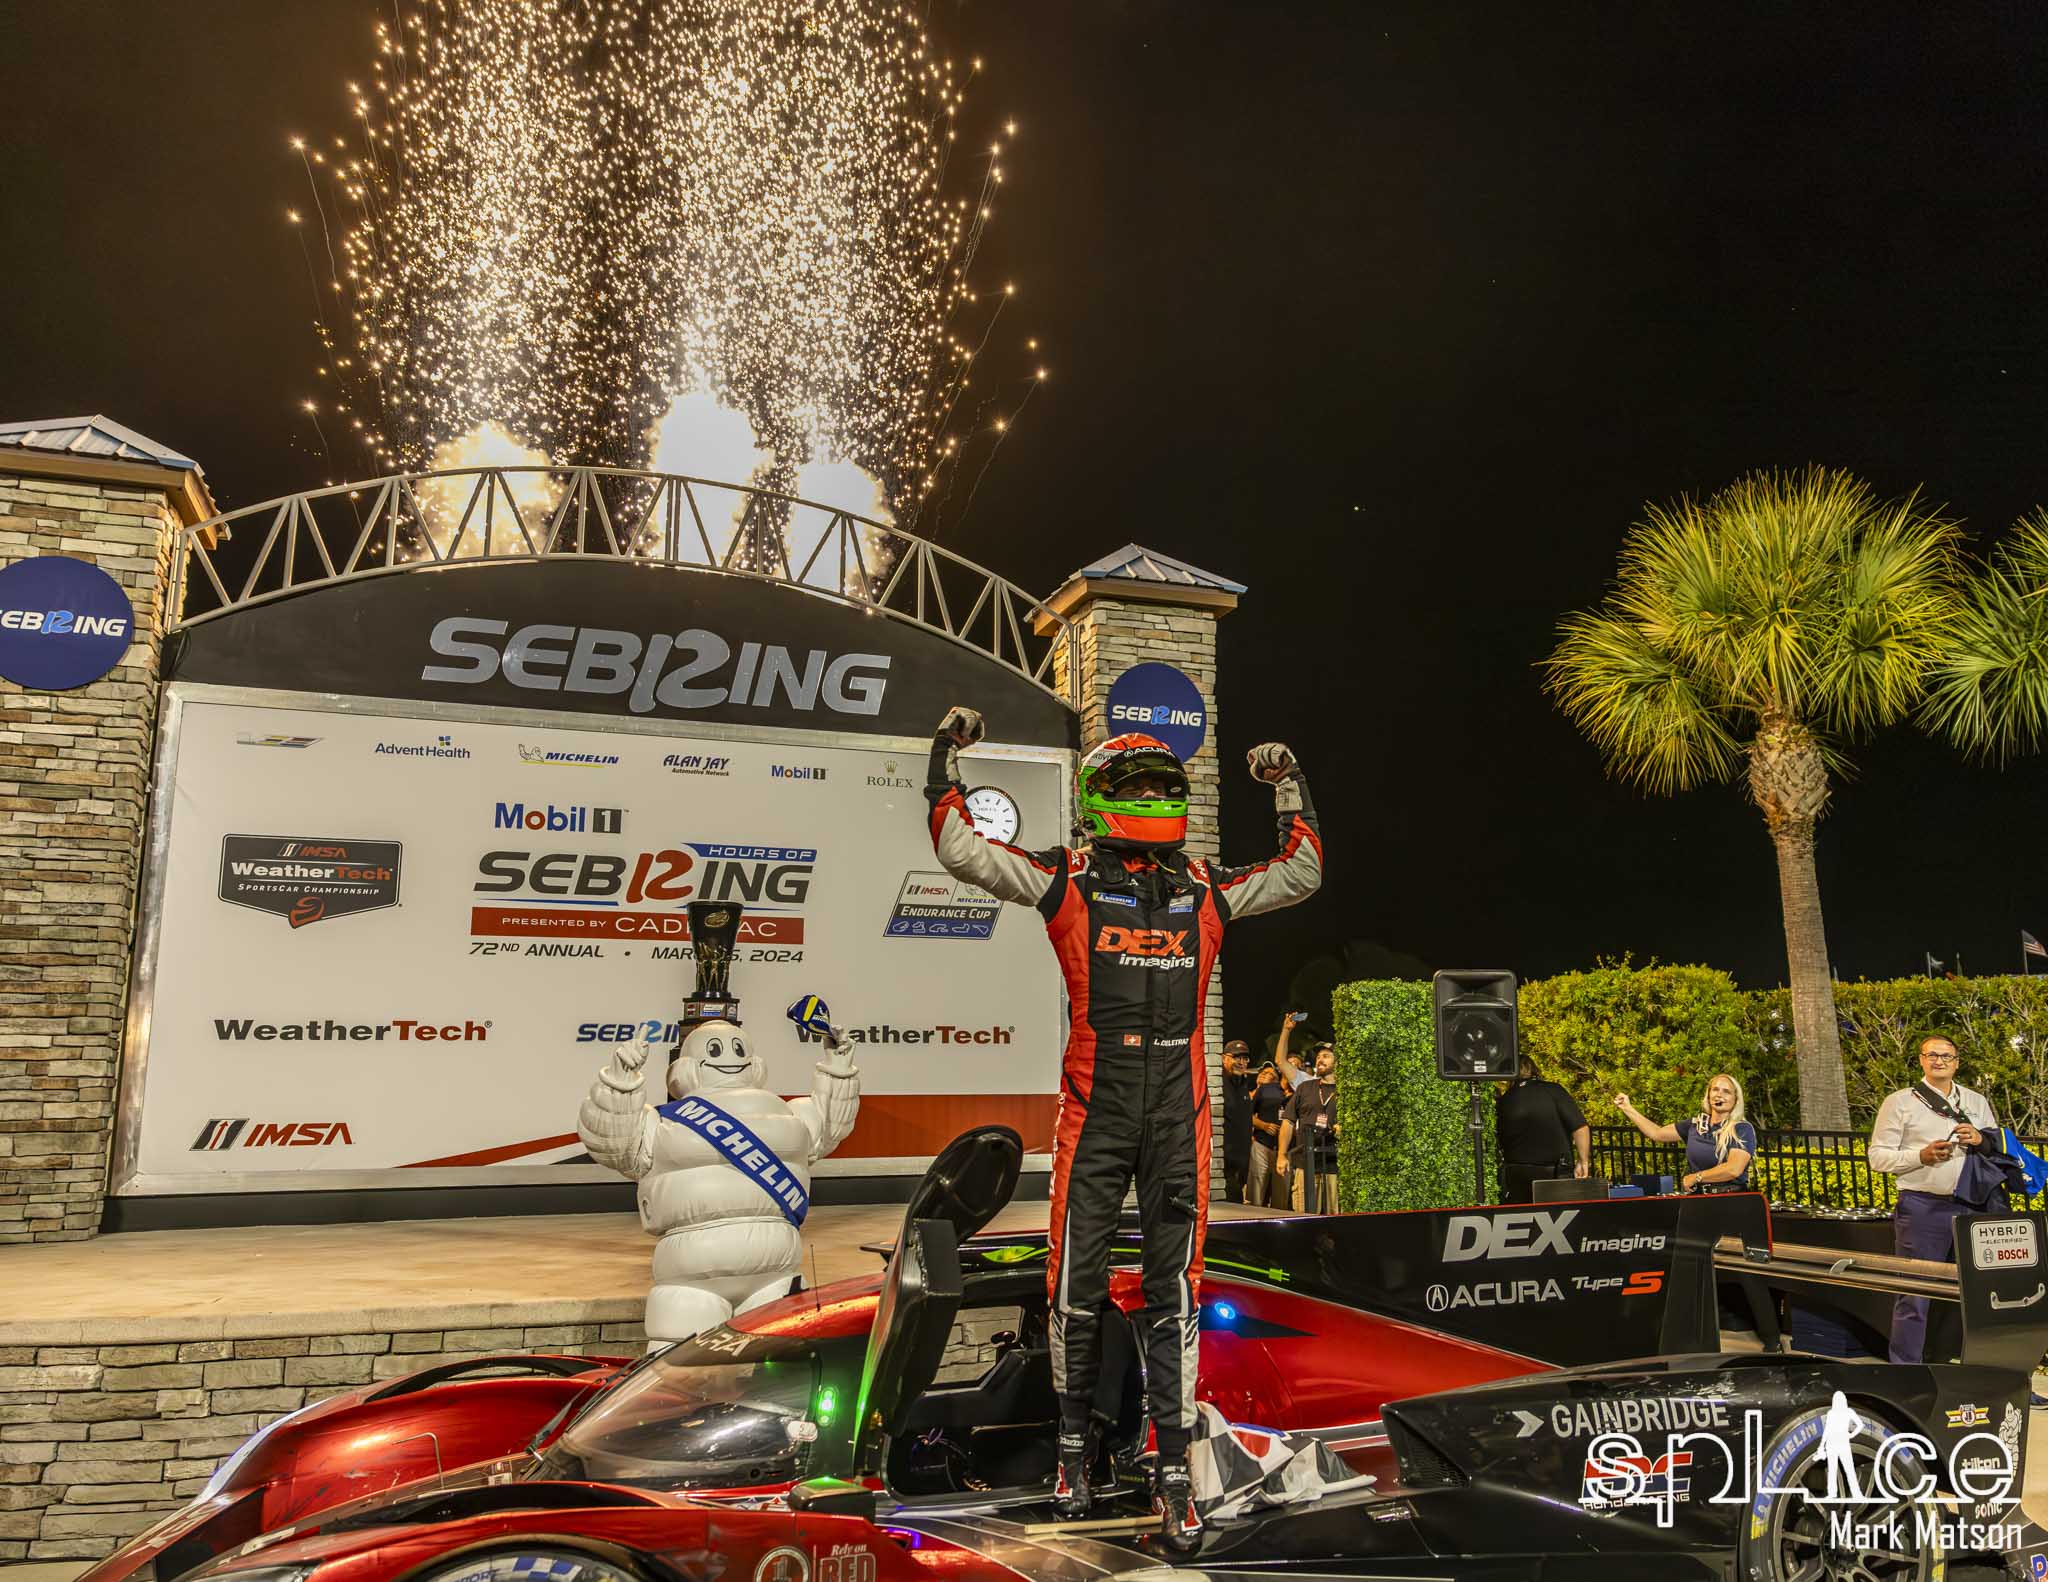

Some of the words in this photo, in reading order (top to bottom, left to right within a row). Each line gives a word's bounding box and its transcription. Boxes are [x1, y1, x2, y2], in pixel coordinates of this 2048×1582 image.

[375, 742, 471, 759] AdventHealth
[545, 751, 620, 765] MICHELIN
[663, 754, 702, 768] ALAN
[703, 757, 731, 770] JAY
[771, 765, 810, 779] Mobil
[814, 768, 825, 780] 1
[866, 776, 914, 789] ROLEX
[494, 802, 586, 833] Mobil
[596, 809, 619, 832] 1
[299, 846, 349, 859] IMSA
[708, 845, 780, 859] HOURS
[785, 848, 814, 860] OF
[231, 861, 392, 881] WeatherTech
[920, 887, 950, 896] IMSA
[956, 897, 998, 905] MICHELIN
[502, 917, 586, 928] PRESENTED
[588, 919, 608, 929] BY
[615, 917, 779, 937] CADIAC
[1095, 925, 1190, 957] DEX
[469, 942, 520, 957] 72ND
[525, 944, 605, 959] ANNUAL
[651, 946, 702, 961] MAR
[749, 949, 805, 963] 2024
[1118, 953, 1196, 970] imaging
[243, 1122, 354, 1147] IMSA
[675, 1100, 805, 1211] MICHELIN
[1441, 1209, 1580, 1263] DEX
[1579, 1234, 1667, 1253] imaging
[1979, 1225, 2028, 1238] HYBRID
[1997, 1248, 2029, 1261] BOSCH
[1450, 1280, 1566, 1309] ACURA
[1571, 1275, 1624, 1291] Type
[1621, 1270, 1665, 1296] S
[1551, 1394, 1730, 1439] GAINBRIDGE
[831, 1543, 852, 1557] Rely
[853, 1543, 868, 1553] on
